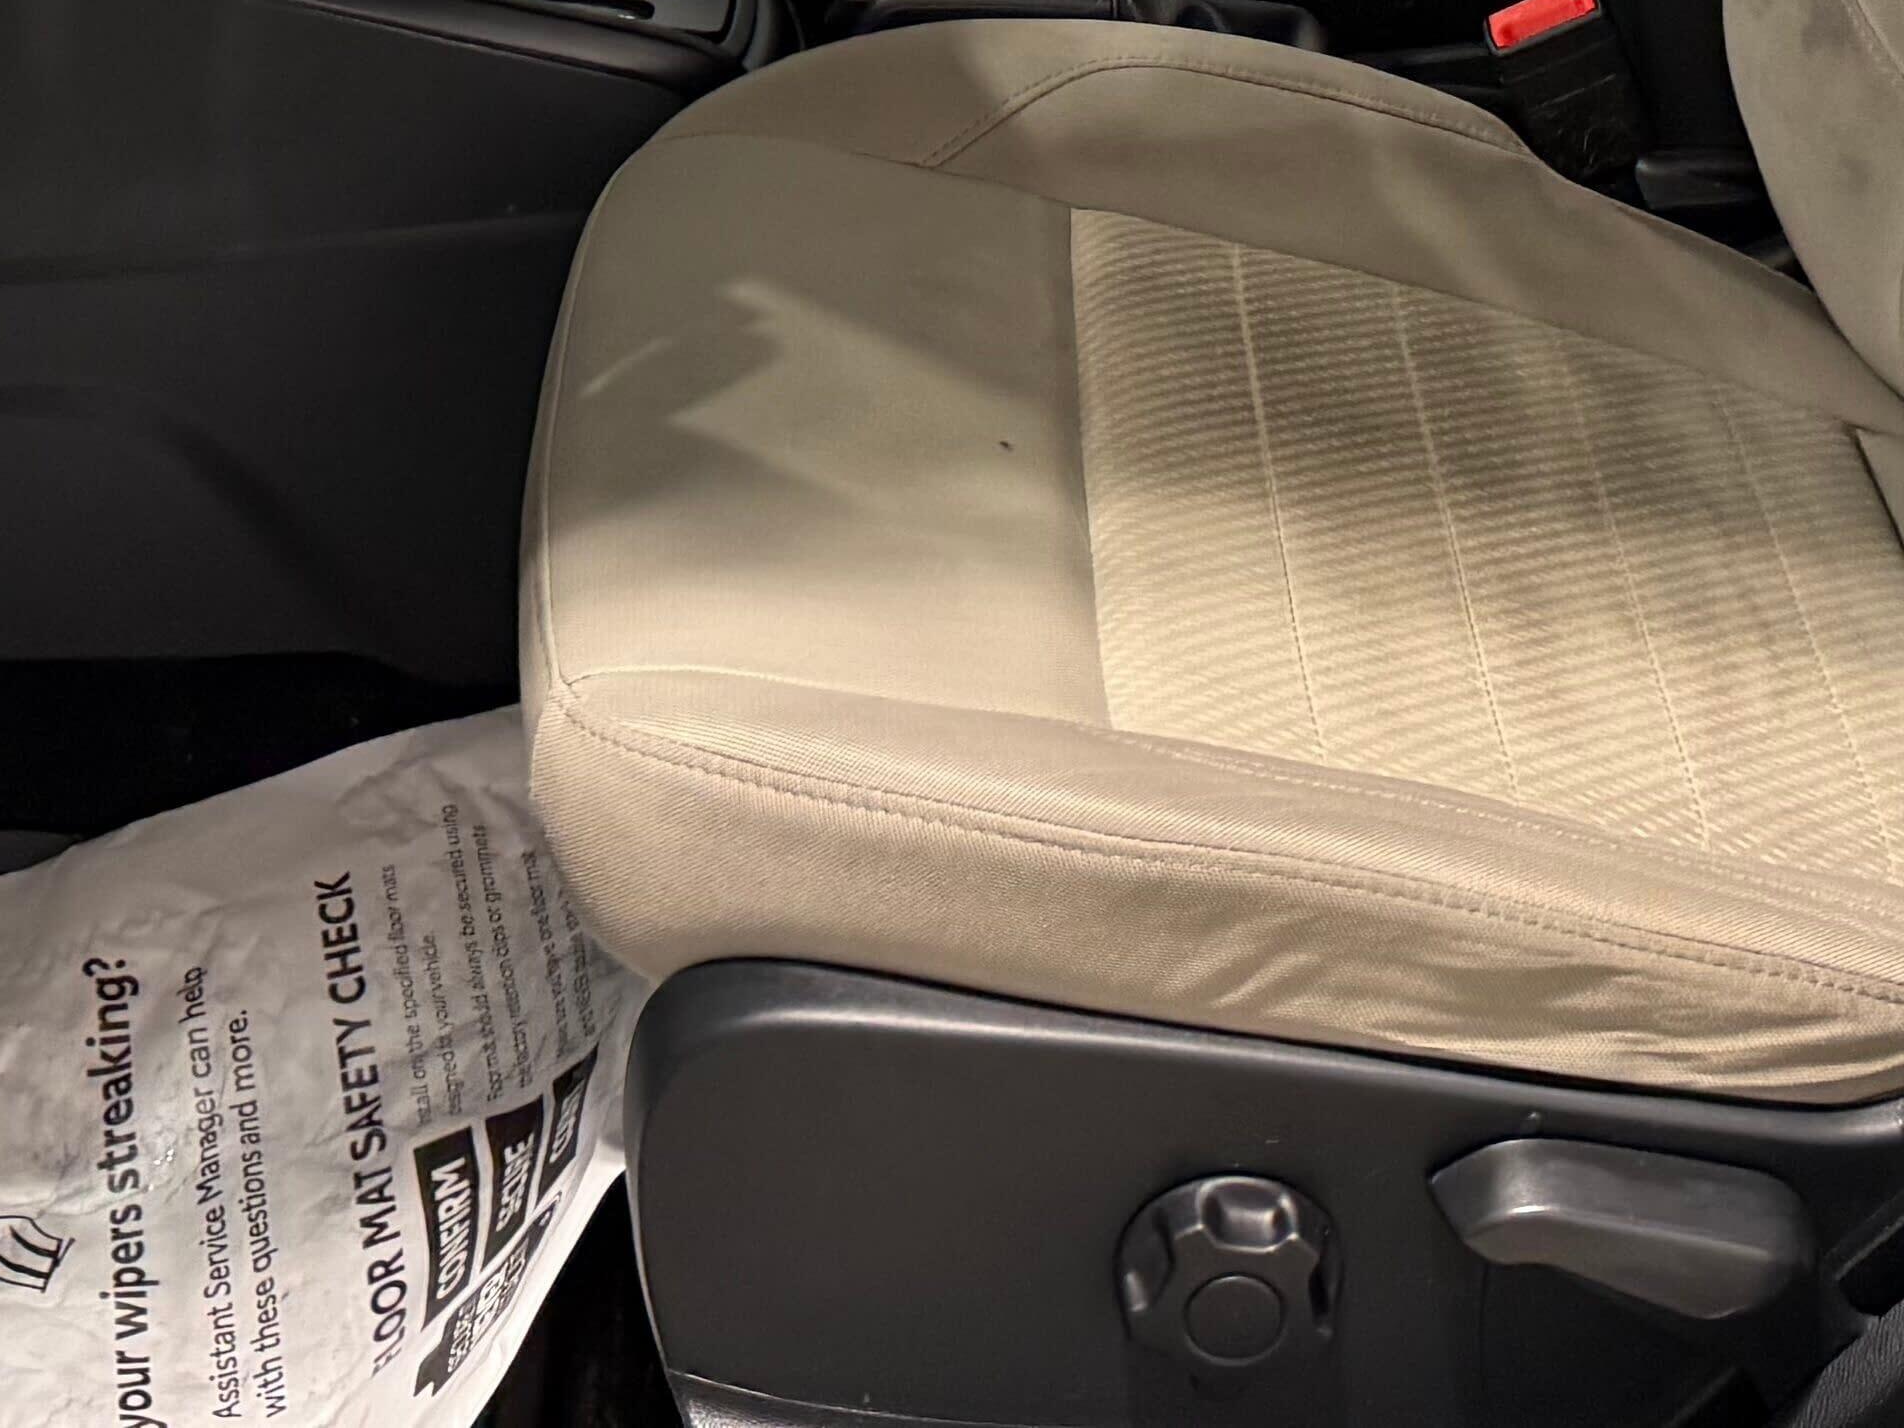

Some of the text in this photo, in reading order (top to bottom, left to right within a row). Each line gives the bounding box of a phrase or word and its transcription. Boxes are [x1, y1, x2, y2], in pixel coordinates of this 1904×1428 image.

[440, 805, 460, 845] using
[446, 850, 472, 911] secured
[314, 871, 366, 1005] CHECK
[389, 945, 420, 1017] specified
[457, 915, 475, 935] be
[82, 956, 142, 1196] streaking?
[333, 1017, 387, 1165] SAFETY
[176, 965, 242, 1419] Assistant Service Manager can help
[229, 1009, 287, 1418] with these questions and more.
[353, 1166, 404, 1250] MAT
[431, 1156, 471, 1300] CONFIRM
[99, 1203, 160, 1340] wipers
